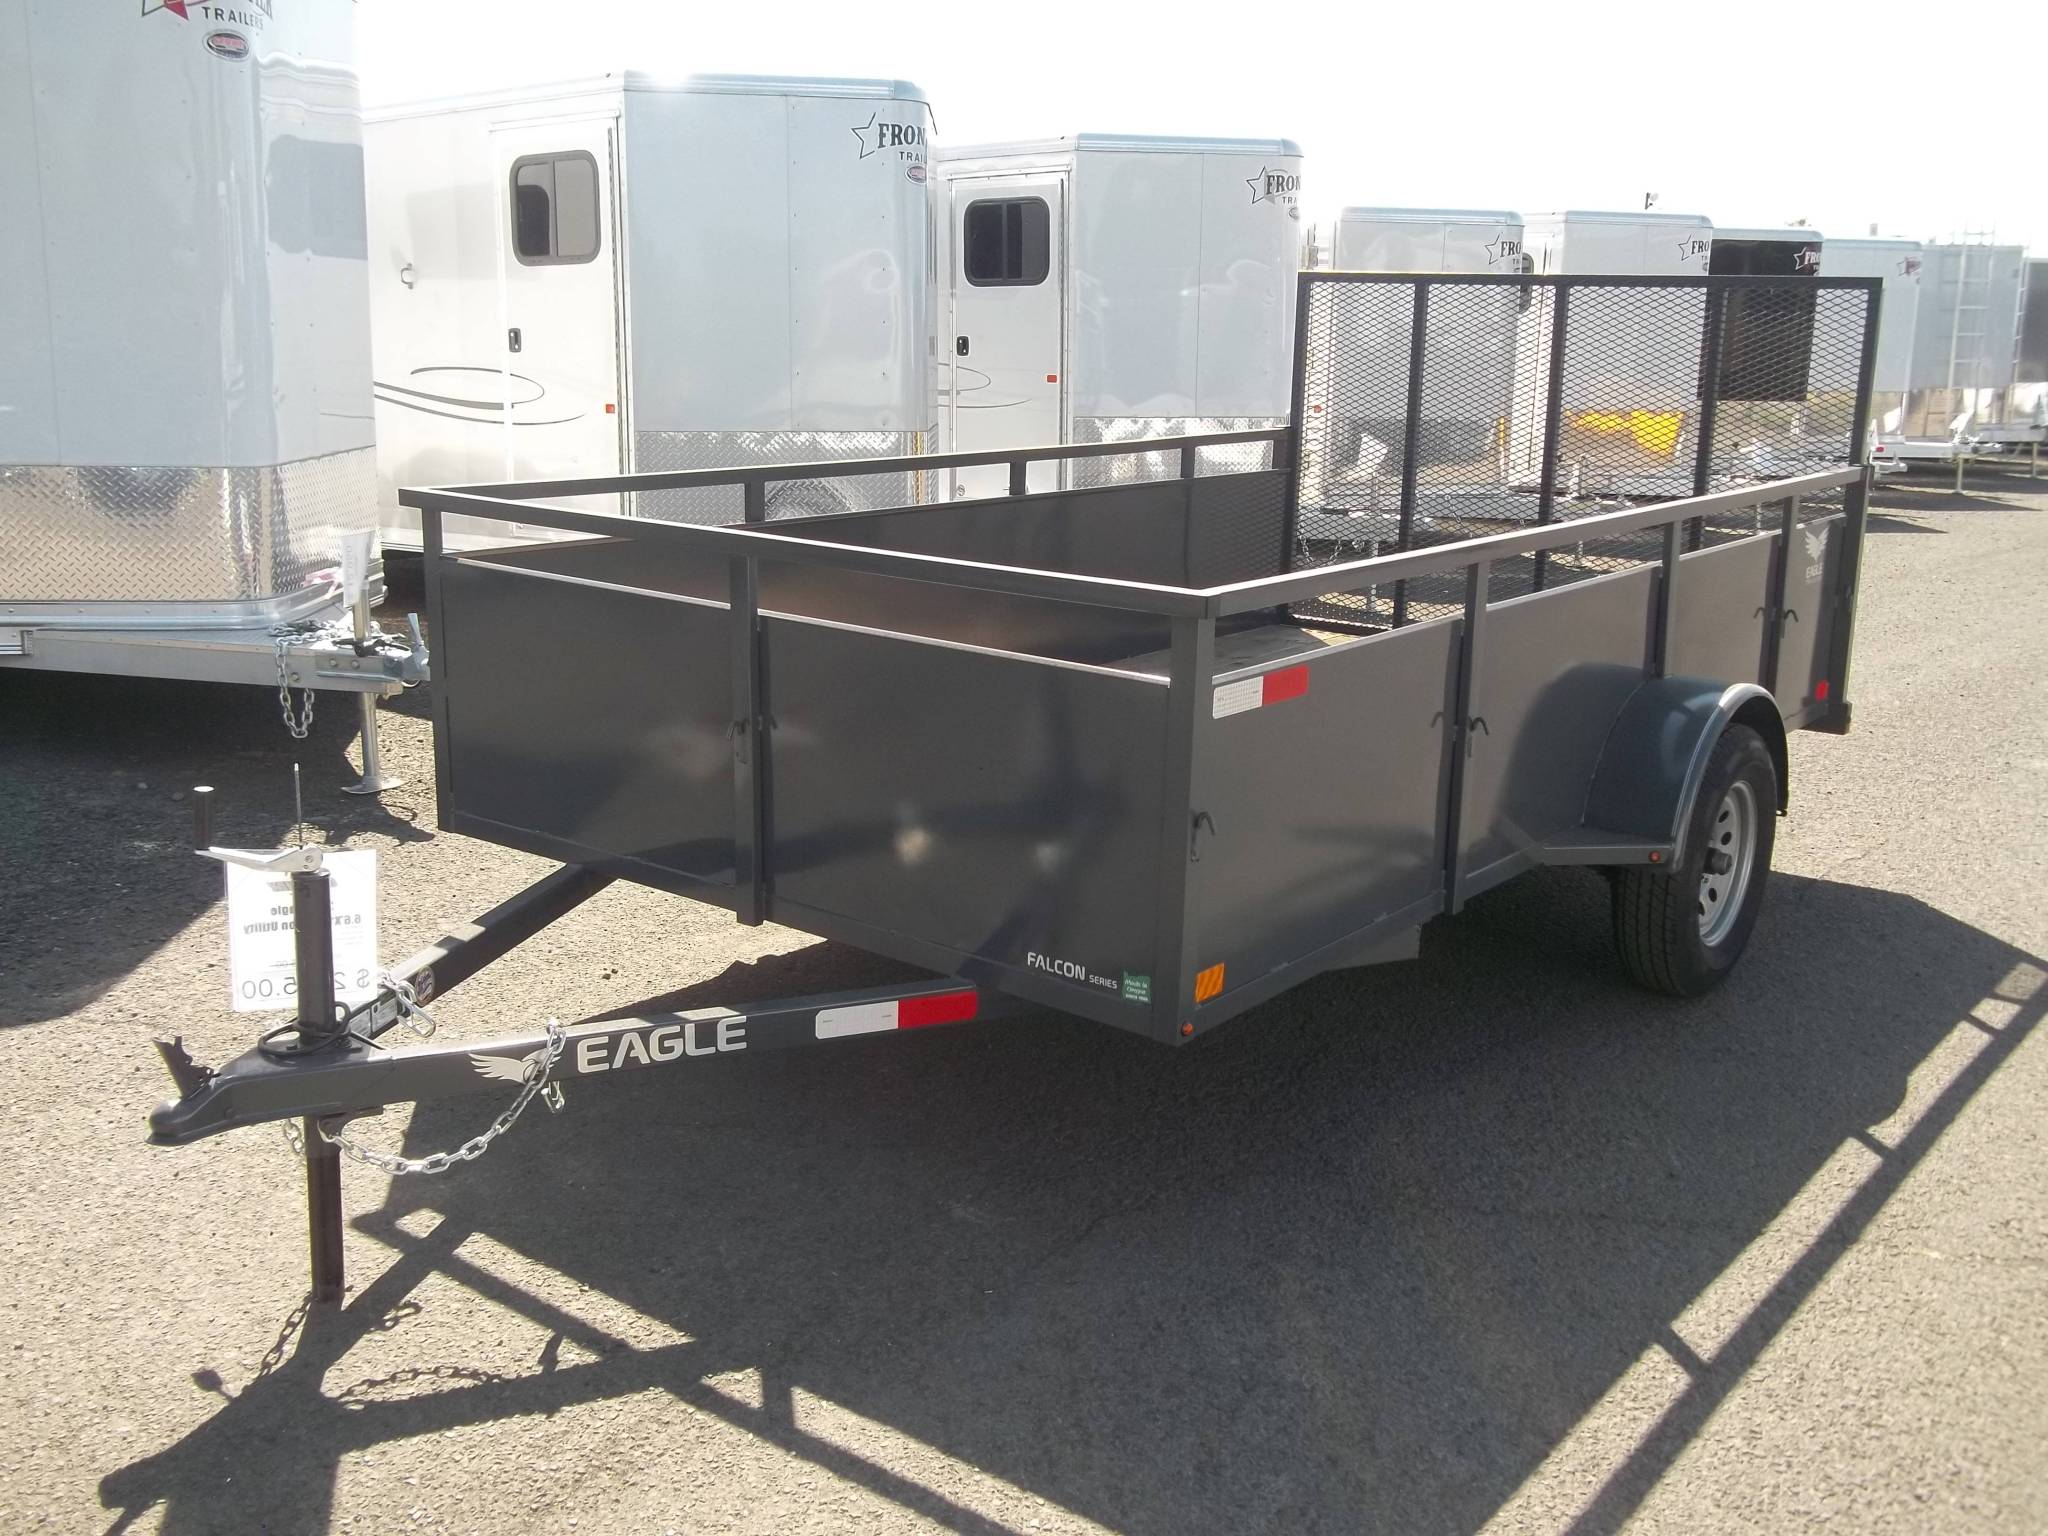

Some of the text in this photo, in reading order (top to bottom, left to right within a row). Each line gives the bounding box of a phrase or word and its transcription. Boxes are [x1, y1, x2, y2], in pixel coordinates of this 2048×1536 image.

[201, 6, 263, 30] TRAILERS
[1690, 240, 1709, 255] FRO
[1027, 951, 1118, 990] FALCON SERIES
[577, 1015, 748, 1074] EAGLE
